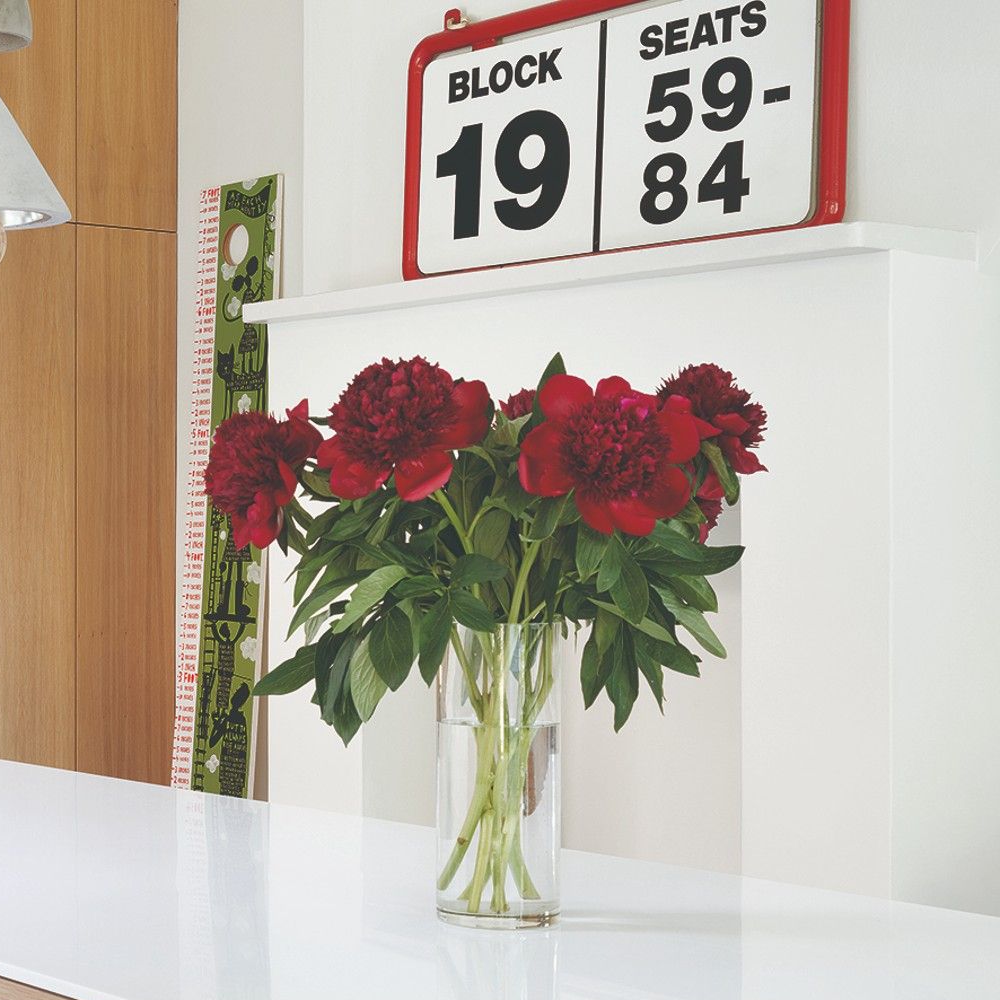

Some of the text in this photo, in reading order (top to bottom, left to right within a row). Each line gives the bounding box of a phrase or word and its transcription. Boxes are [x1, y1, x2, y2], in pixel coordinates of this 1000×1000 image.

[639, 0, 767, 61] SEATS
[448, 48, 563, 104] BLOCK
[645, 56, 791, 143] 59-
[436, 109, 571, 240] 19
[640, 140, 750, 225] 84
